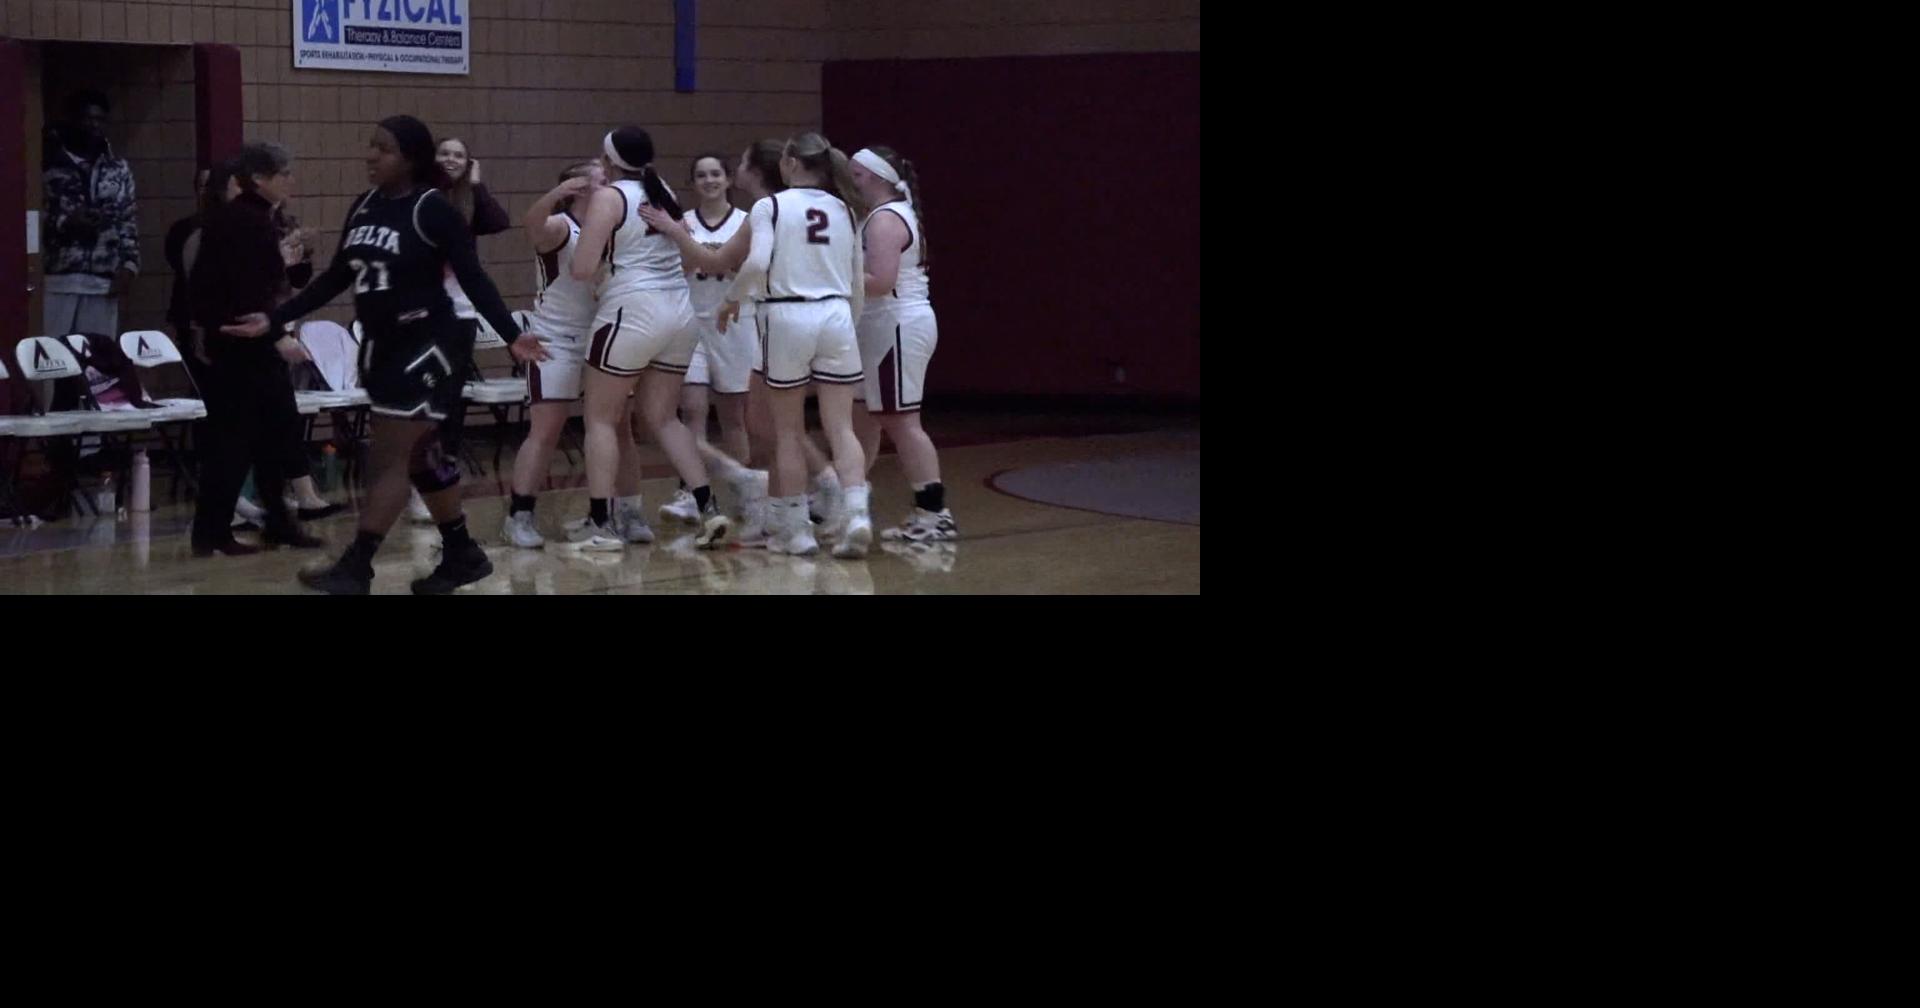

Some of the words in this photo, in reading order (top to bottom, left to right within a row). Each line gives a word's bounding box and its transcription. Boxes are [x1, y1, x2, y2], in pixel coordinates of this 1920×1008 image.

[346, 28, 381, 43] Therapy
[382, 30, 389, 43] &
[391, 30, 427, 46] Balance
[428, 32, 461, 47] Centers
[300, 49, 320, 58] SPORTS
[368, 52, 393, 61] PHYSICAL
[343, 225, 400, 255] DELTA
[806, 208, 830, 245] 2
[349, 259, 391, 293] 21
